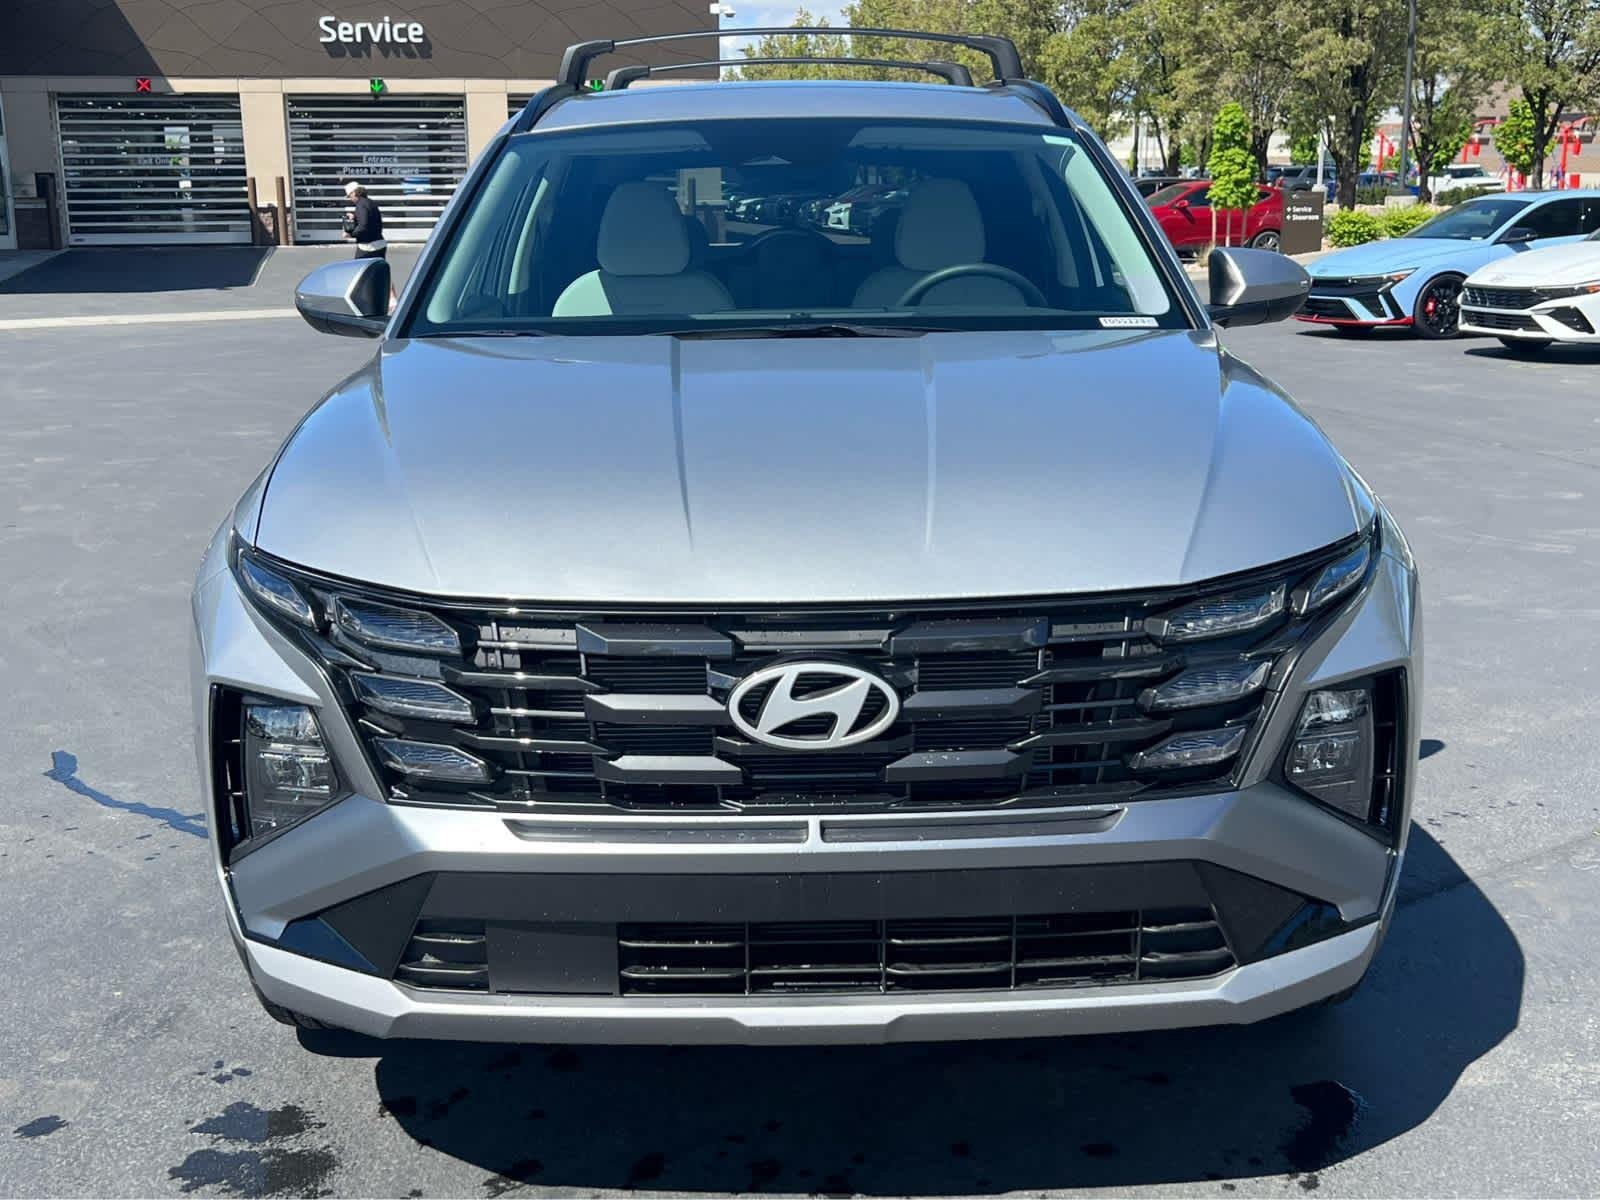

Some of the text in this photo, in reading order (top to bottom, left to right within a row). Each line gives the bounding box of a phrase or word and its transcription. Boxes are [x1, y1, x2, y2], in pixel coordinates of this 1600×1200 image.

[319, 16, 423, 43] Service
[342, 166, 368, 175] Please
[370, 166, 385, 175] Pull
